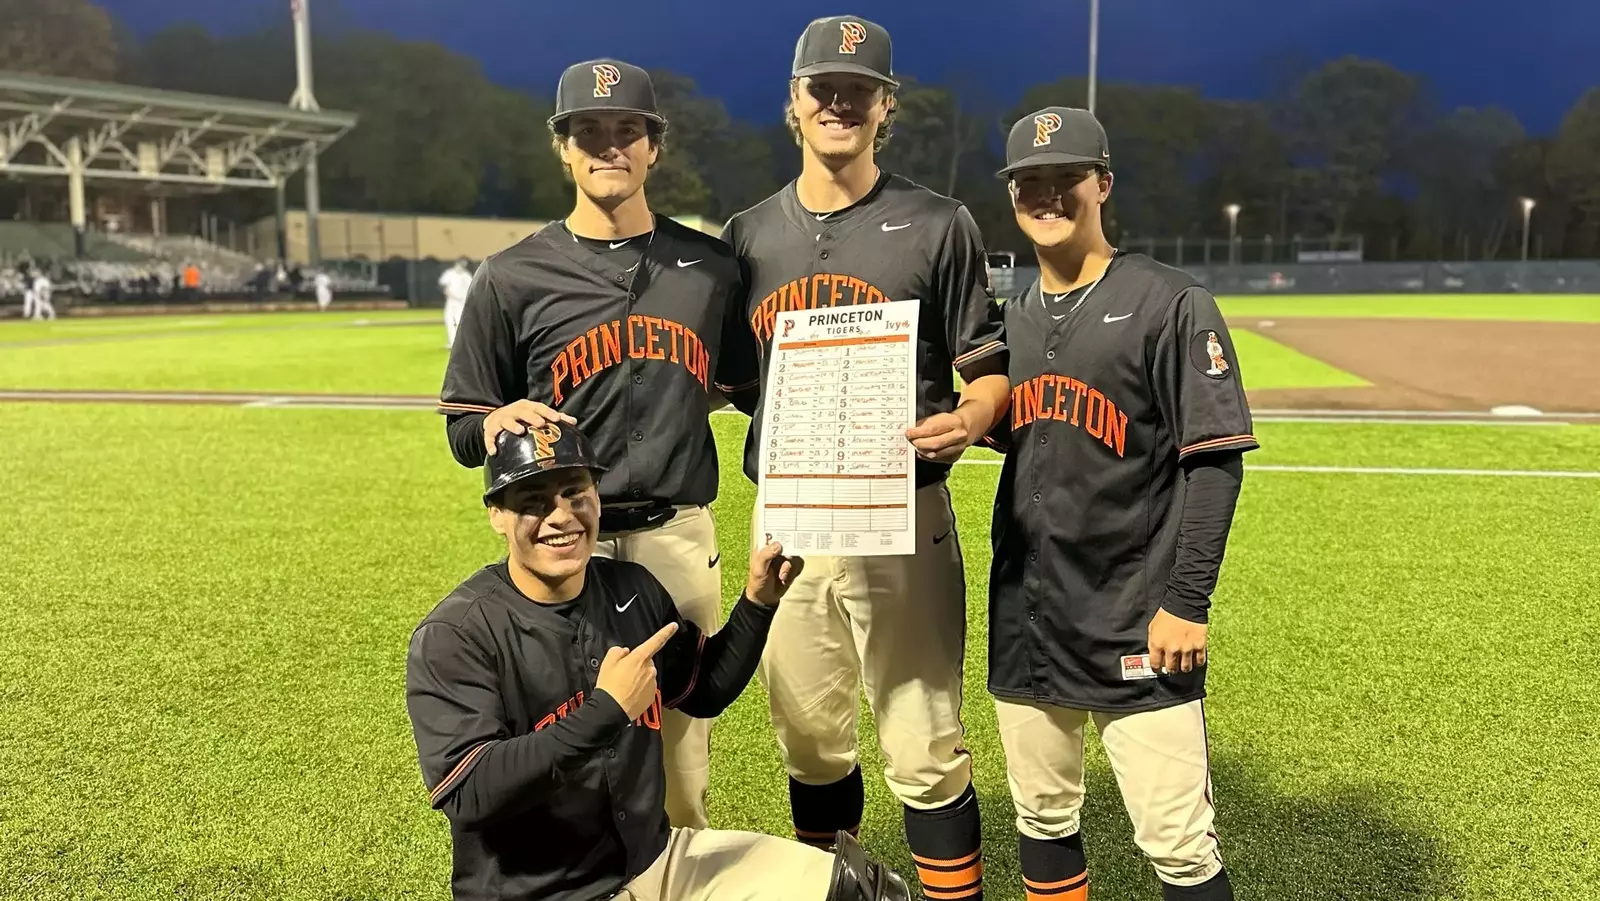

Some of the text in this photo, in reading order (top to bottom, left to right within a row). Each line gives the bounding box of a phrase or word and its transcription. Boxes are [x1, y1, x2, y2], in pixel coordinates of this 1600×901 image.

[839, 21, 867, 54] P
[592, 64, 621, 98] P
[1033, 113, 1062, 147] P
[782, 319, 796, 338] P
[808, 309, 883, 326] PRINCETON
[826, 325, 861, 335] TIGERS
[551, 314, 710, 407] PRINCETON
[1012, 374, 1128, 458] INCETON
[527, 422, 562, 460] P
